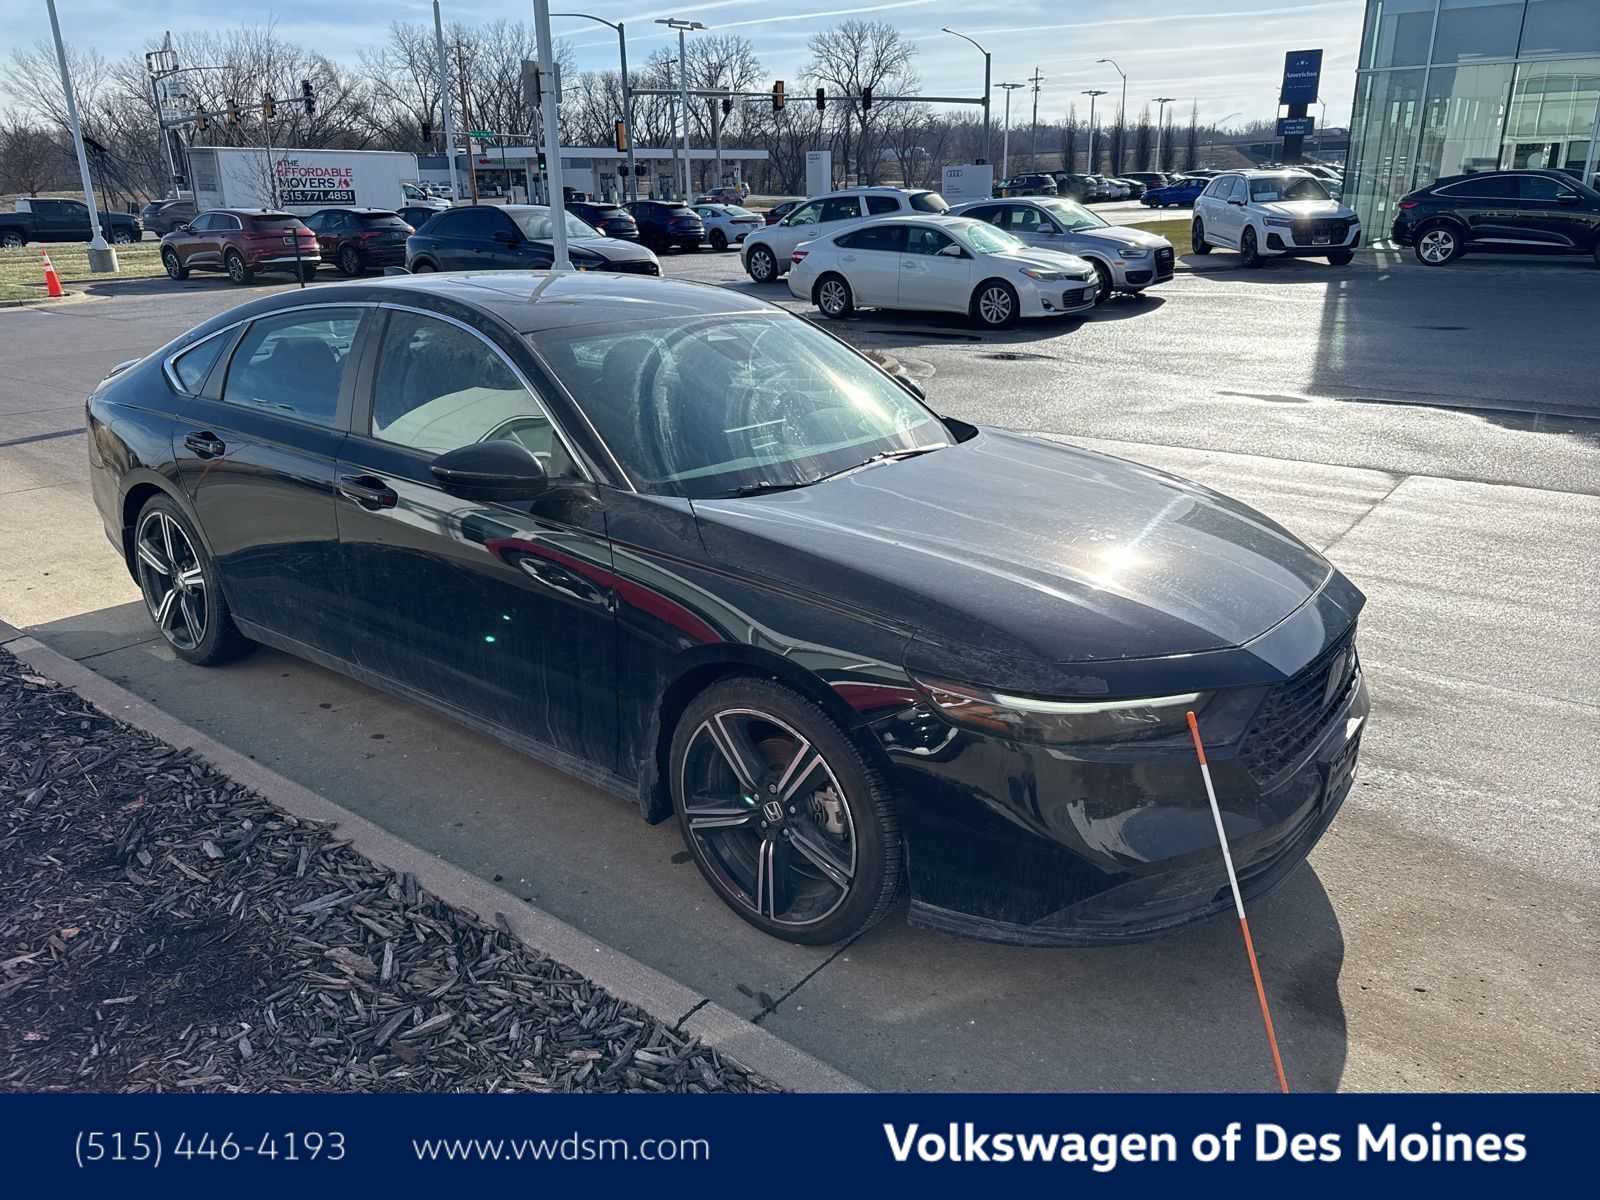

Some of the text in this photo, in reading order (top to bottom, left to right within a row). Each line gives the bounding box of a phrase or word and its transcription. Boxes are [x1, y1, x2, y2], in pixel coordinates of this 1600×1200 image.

[283, 159, 300, 167] THE
[276, 167, 353, 177] AFFORDABLE
[279, 177, 336, 189] MOVERS
